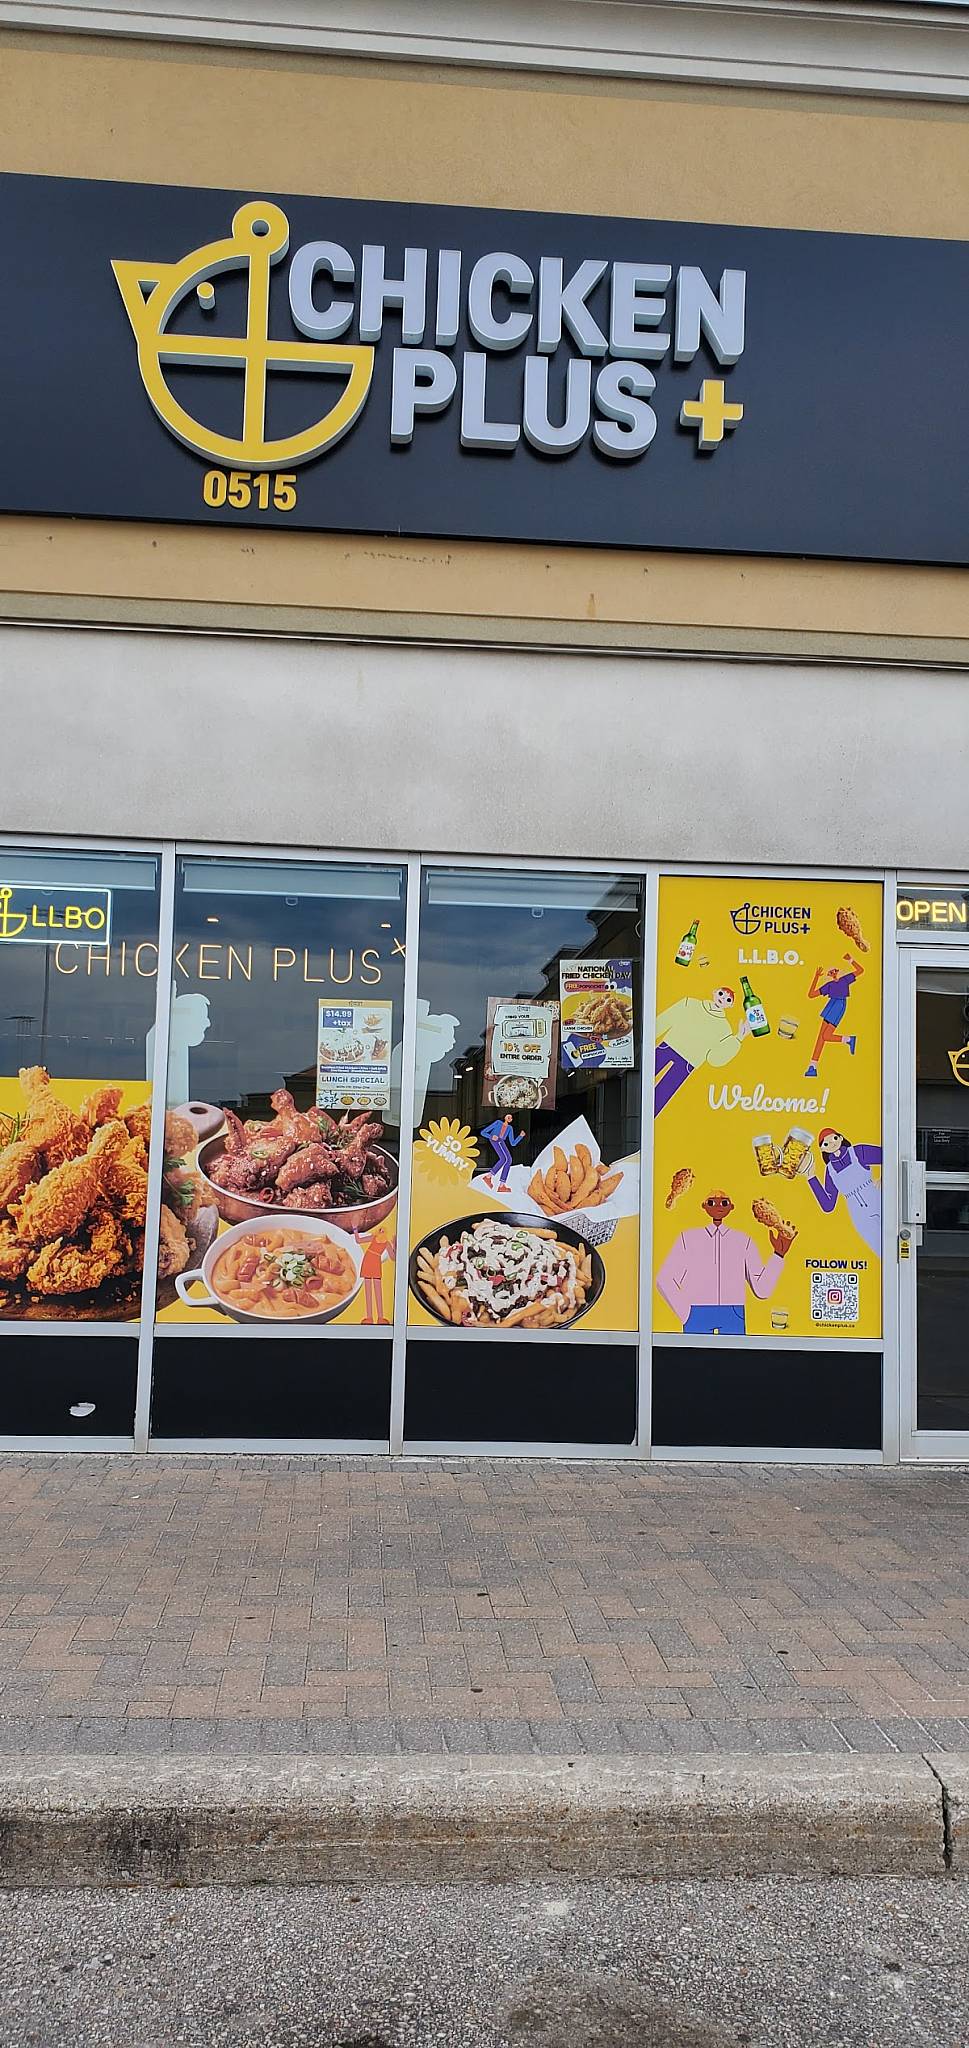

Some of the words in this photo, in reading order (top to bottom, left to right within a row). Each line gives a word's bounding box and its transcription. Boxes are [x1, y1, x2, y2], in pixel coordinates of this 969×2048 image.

[288, 240, 747, 365] CHICKEN
[202, 470, 298, 511] 0515
[31, 904, 106, 930] LLBO
[751, 905, 811, 919] CHICKEN
[896, 900, 967, 923] OPEN
[738, 948, 805, 966] L.L.B.O.
[577, 965, 614, 973] NATIONAL
[616, 972, 631, 980] DAY
[522, 1043, 541, 1053] OFF
[579, 1043, 597, 1053] FREE
[708, 1083, 830, 1114] Welcome!
[426, 1135, 470, 1171] YUMMY
[443, 1135, 463, 1153] SO
[805, 1259, 847, 1269] FOLLOW
[850, 1260, 868, 1270] US!
